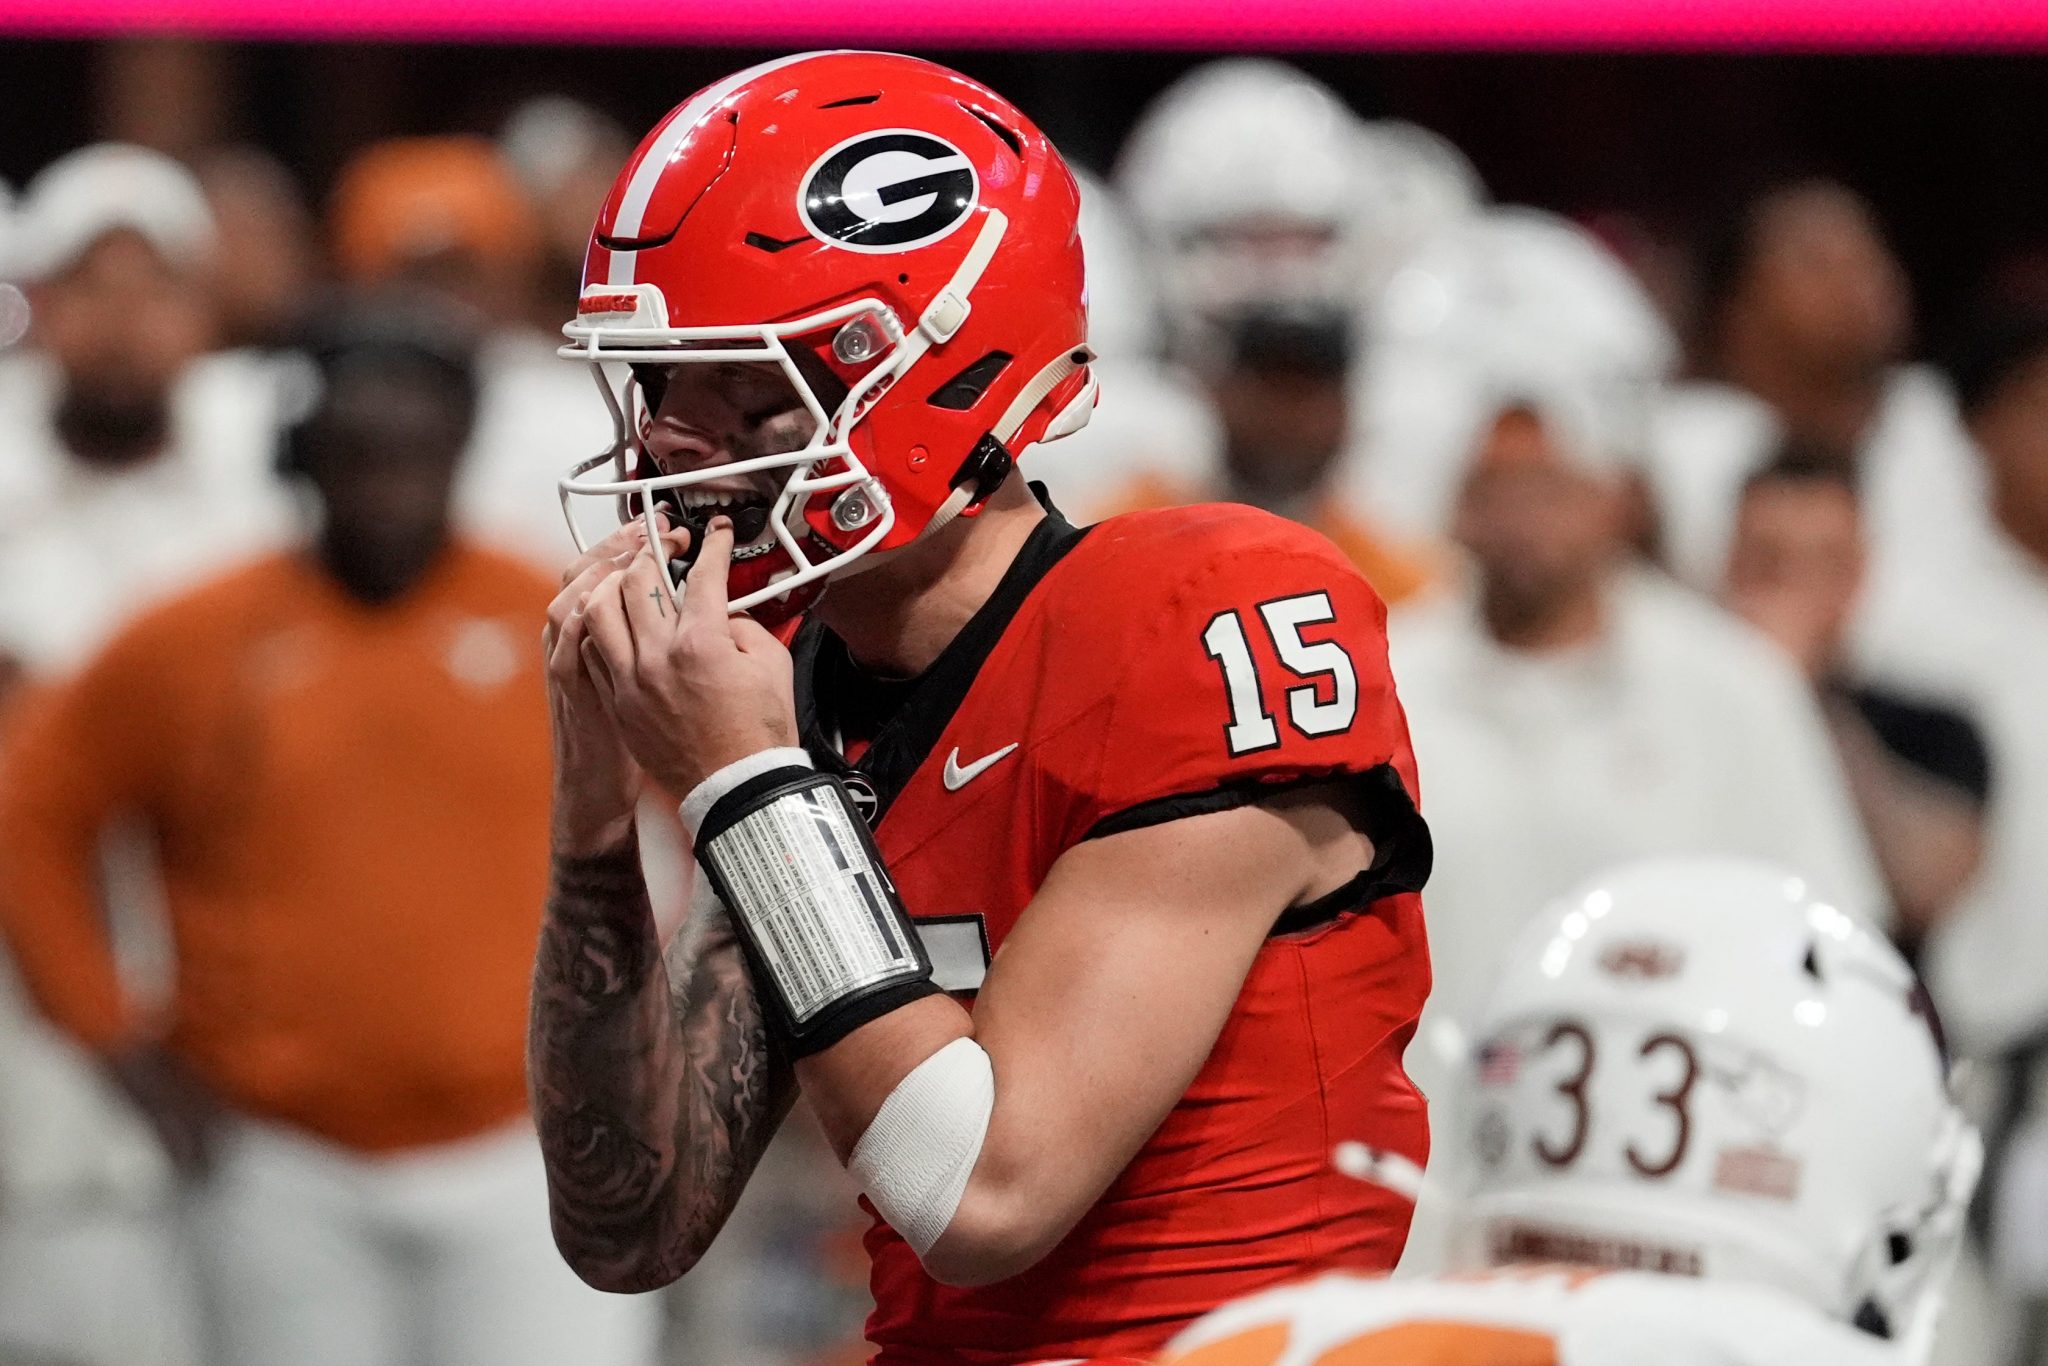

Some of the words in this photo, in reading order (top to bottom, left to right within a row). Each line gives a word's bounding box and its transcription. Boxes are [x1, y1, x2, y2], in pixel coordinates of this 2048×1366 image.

[804, 133, 975, 248] G
[1200, 589, 1359, 759] 15
[1531, 1019, 1699, 1178] 33
